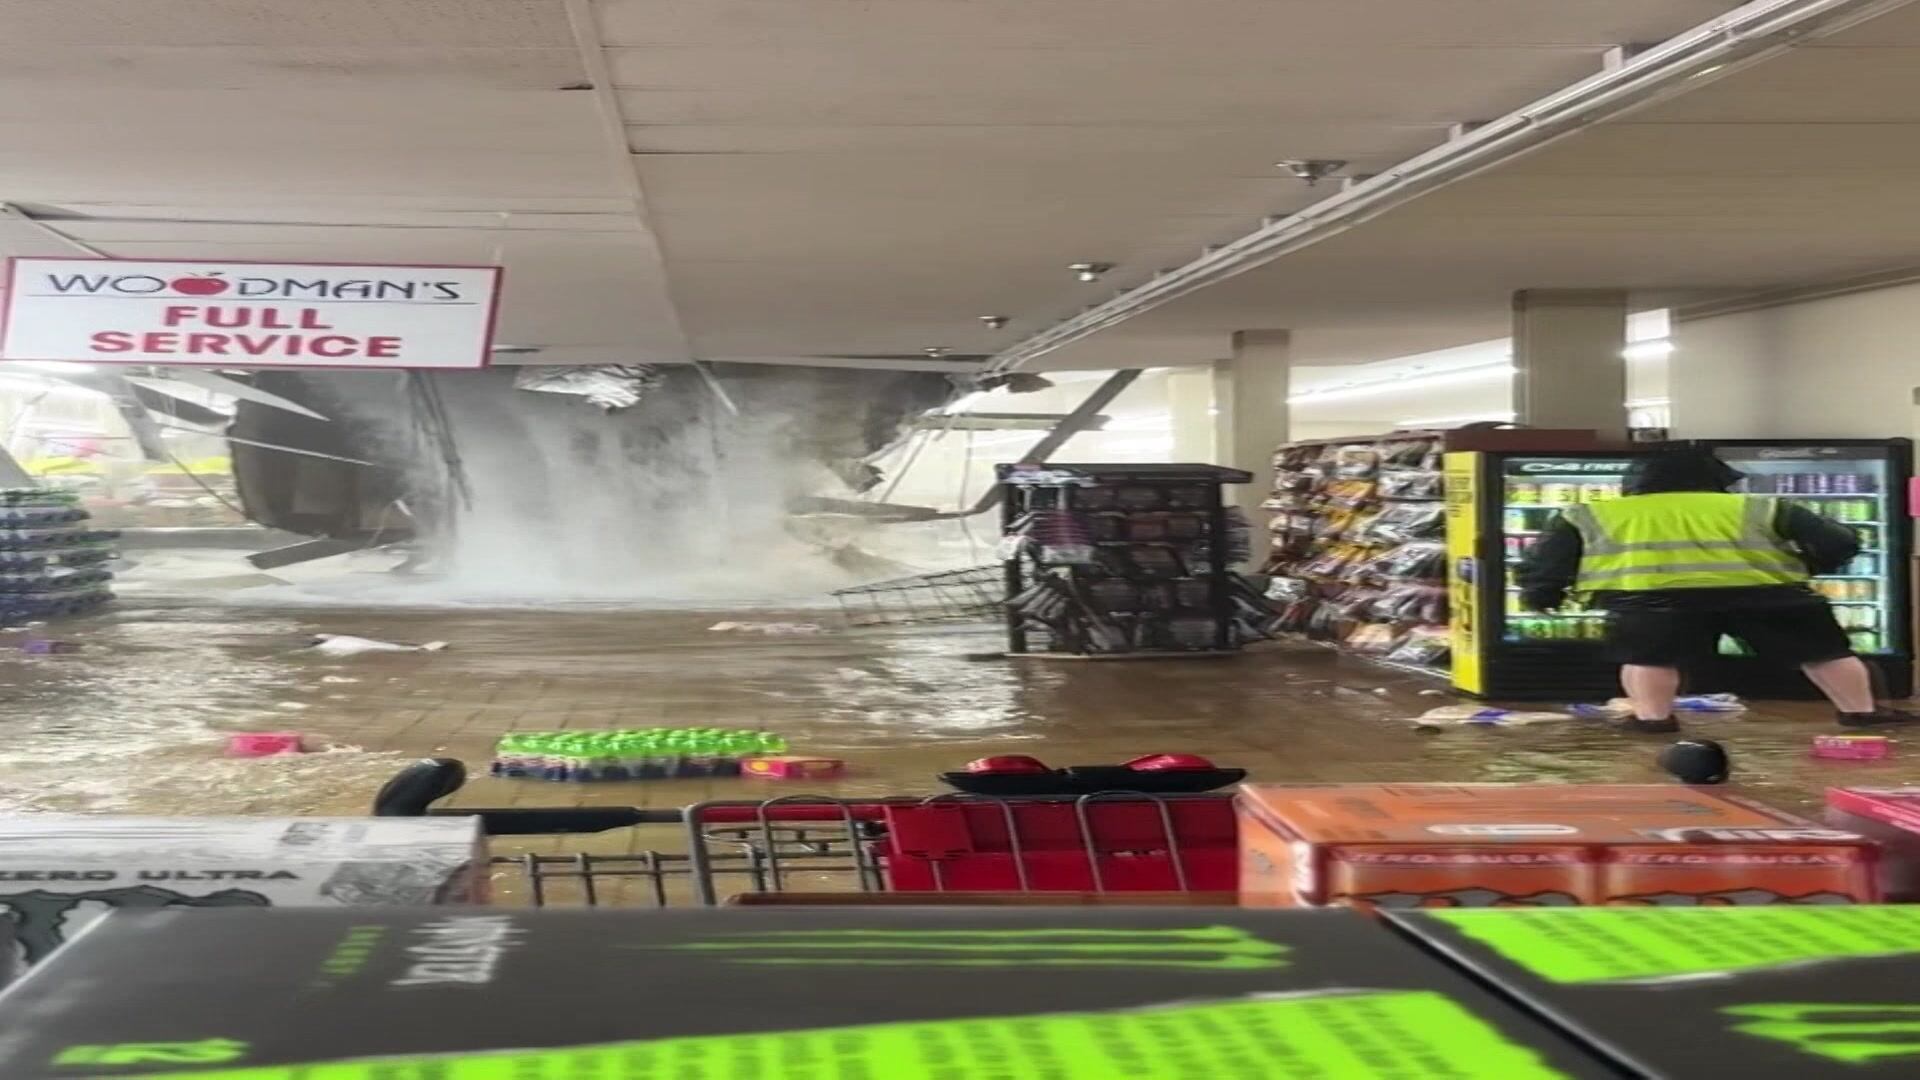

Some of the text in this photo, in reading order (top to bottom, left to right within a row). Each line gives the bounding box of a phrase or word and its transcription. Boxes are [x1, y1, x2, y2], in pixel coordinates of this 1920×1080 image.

[47, 272, 462, 301] WOODMAN'S
[163, 305, 334, 330] FULL
[89, 331, 404, 358] SERVICE
[1350, 853, 1433, 864] ZERO
[1624, 853, 1707, 864] ZERO
[137, 869, 300, 881] ULTRA
